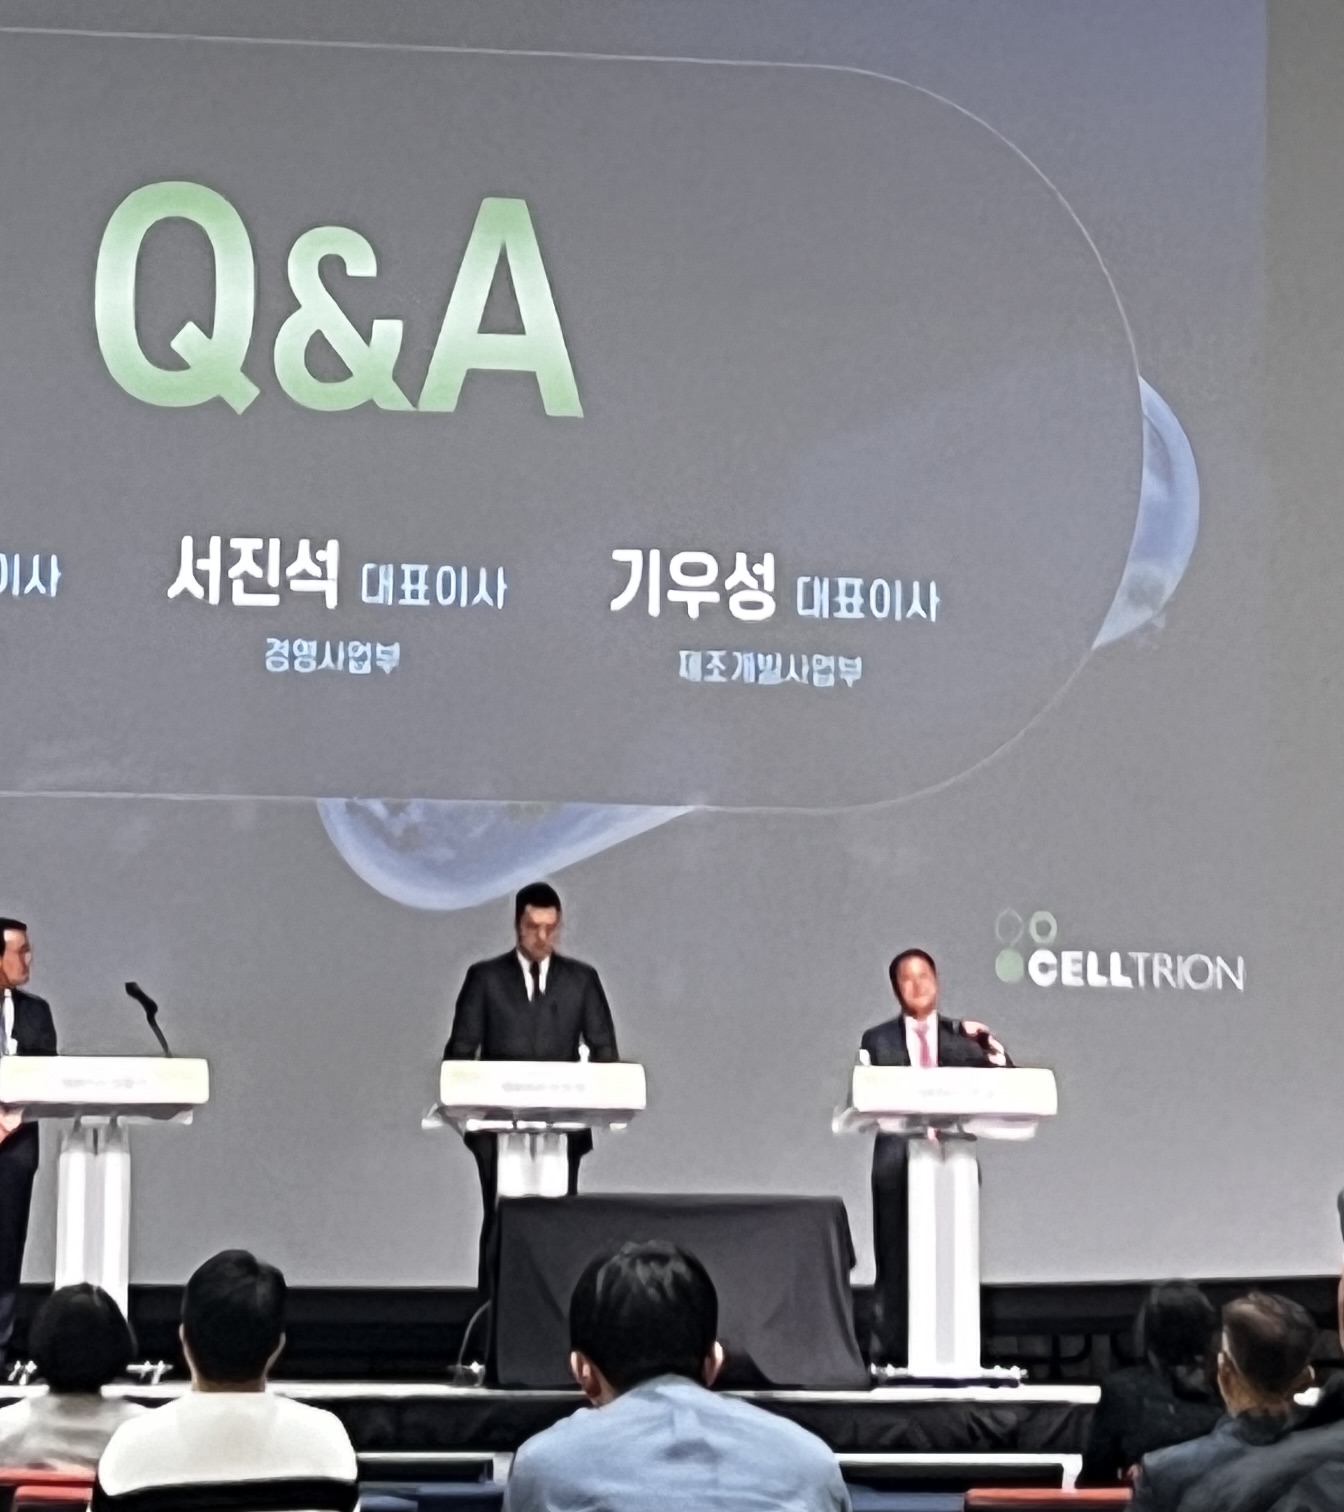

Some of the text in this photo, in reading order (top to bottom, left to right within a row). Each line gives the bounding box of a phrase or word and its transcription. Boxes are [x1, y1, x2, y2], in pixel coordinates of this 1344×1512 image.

[94, 181, 585, 418] Q&A
[167, 535, 508, 610] 서진석 대표이사
[610, 548, 941, 623] 기우성 대표이사
[1027, 948, 1246, 992] CELLTRION
